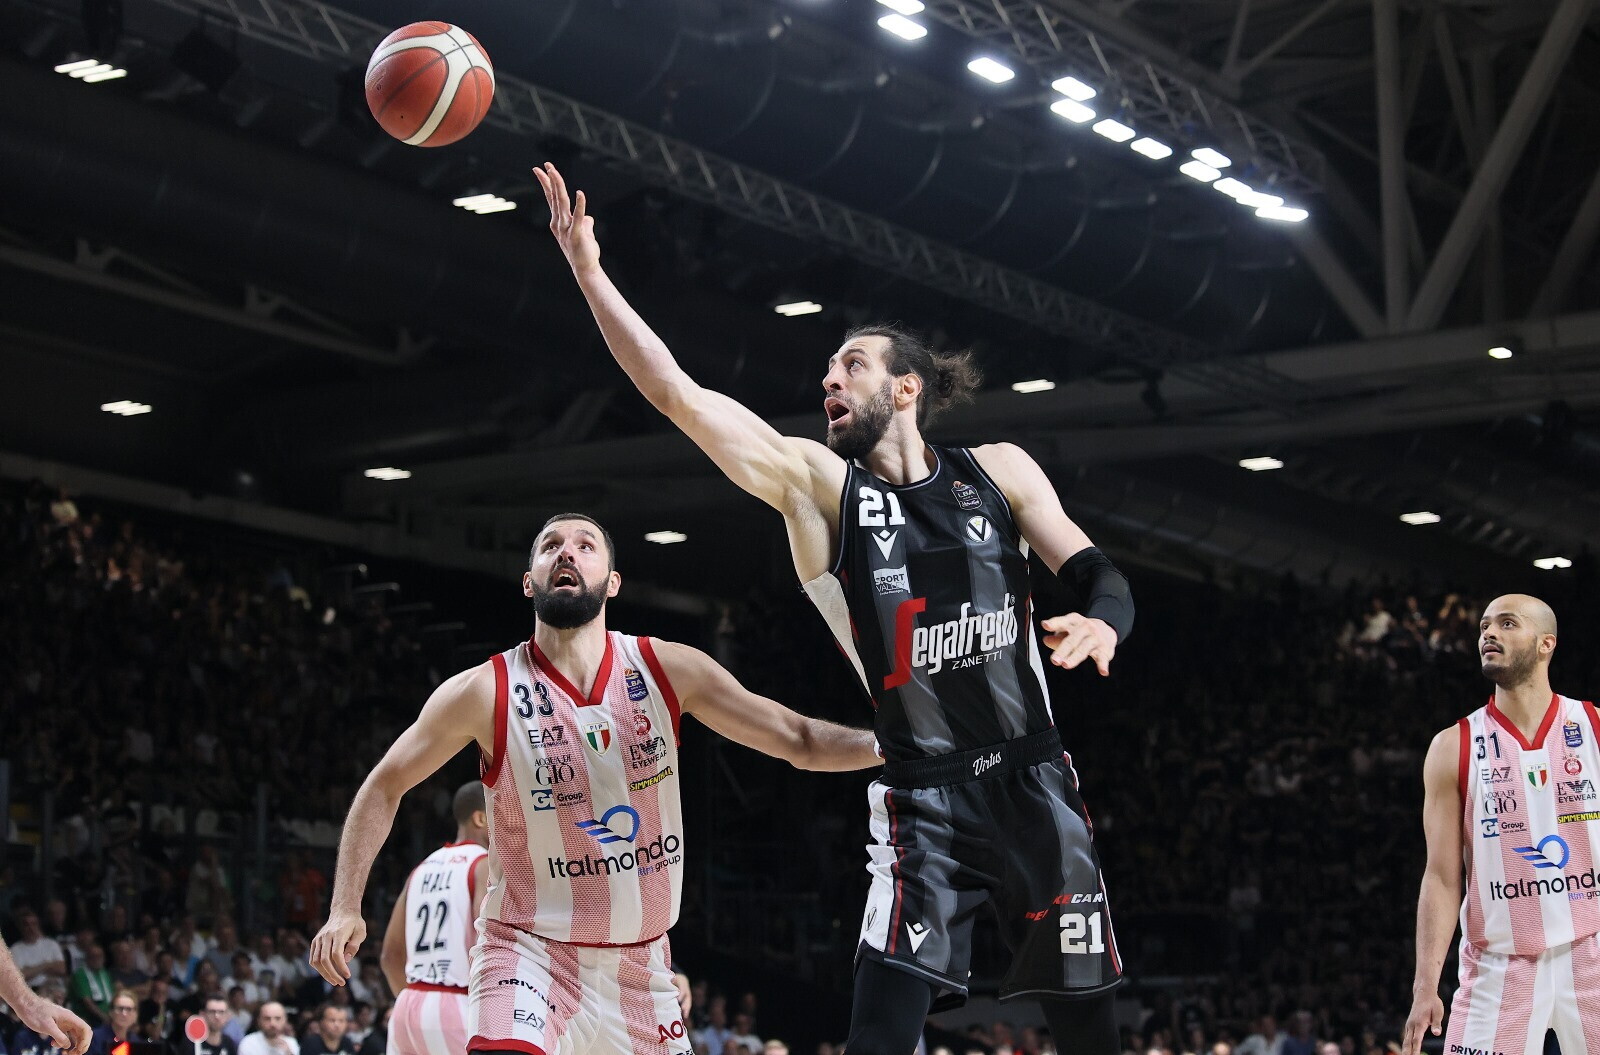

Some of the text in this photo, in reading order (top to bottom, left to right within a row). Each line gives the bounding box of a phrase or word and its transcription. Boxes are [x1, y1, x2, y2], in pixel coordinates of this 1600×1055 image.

[859, 486, 905, 527] 21
[875, 573, 904, 585] SPORT
[952, 650, 1002, 670] ZANETTI
[626, 679, 643, 688] LBA
[513, 681, 555, 720] 33
[528, 725, 564, 744] EA7
[1475, 730, 1502, 761] 31
[632, 750, 667, 769] EYEWEAR
[972, 751, 1002, 776] Virtus
[629, 766, 673, 791] SIMMENTHAL
[1481, 766, 1511, 781] EA7
[557, 792, 584, 802] Group
[1558, 793, 1597, 803] EYEWEAR
[1501, 822, 1524, 830] Group
[548, 834, 680, 878] Italmondo
[655, 854, 681, 873] group
[421, 870, 453, 894] HALL
[1489, 868, 1600, 901] Italmond
[414, 900, 449, 953] 22
[1059, 911, 1105, 954] 21
[513, 1009, 546, 1030] EA7
[657, 1020, 687, 1045] AO
